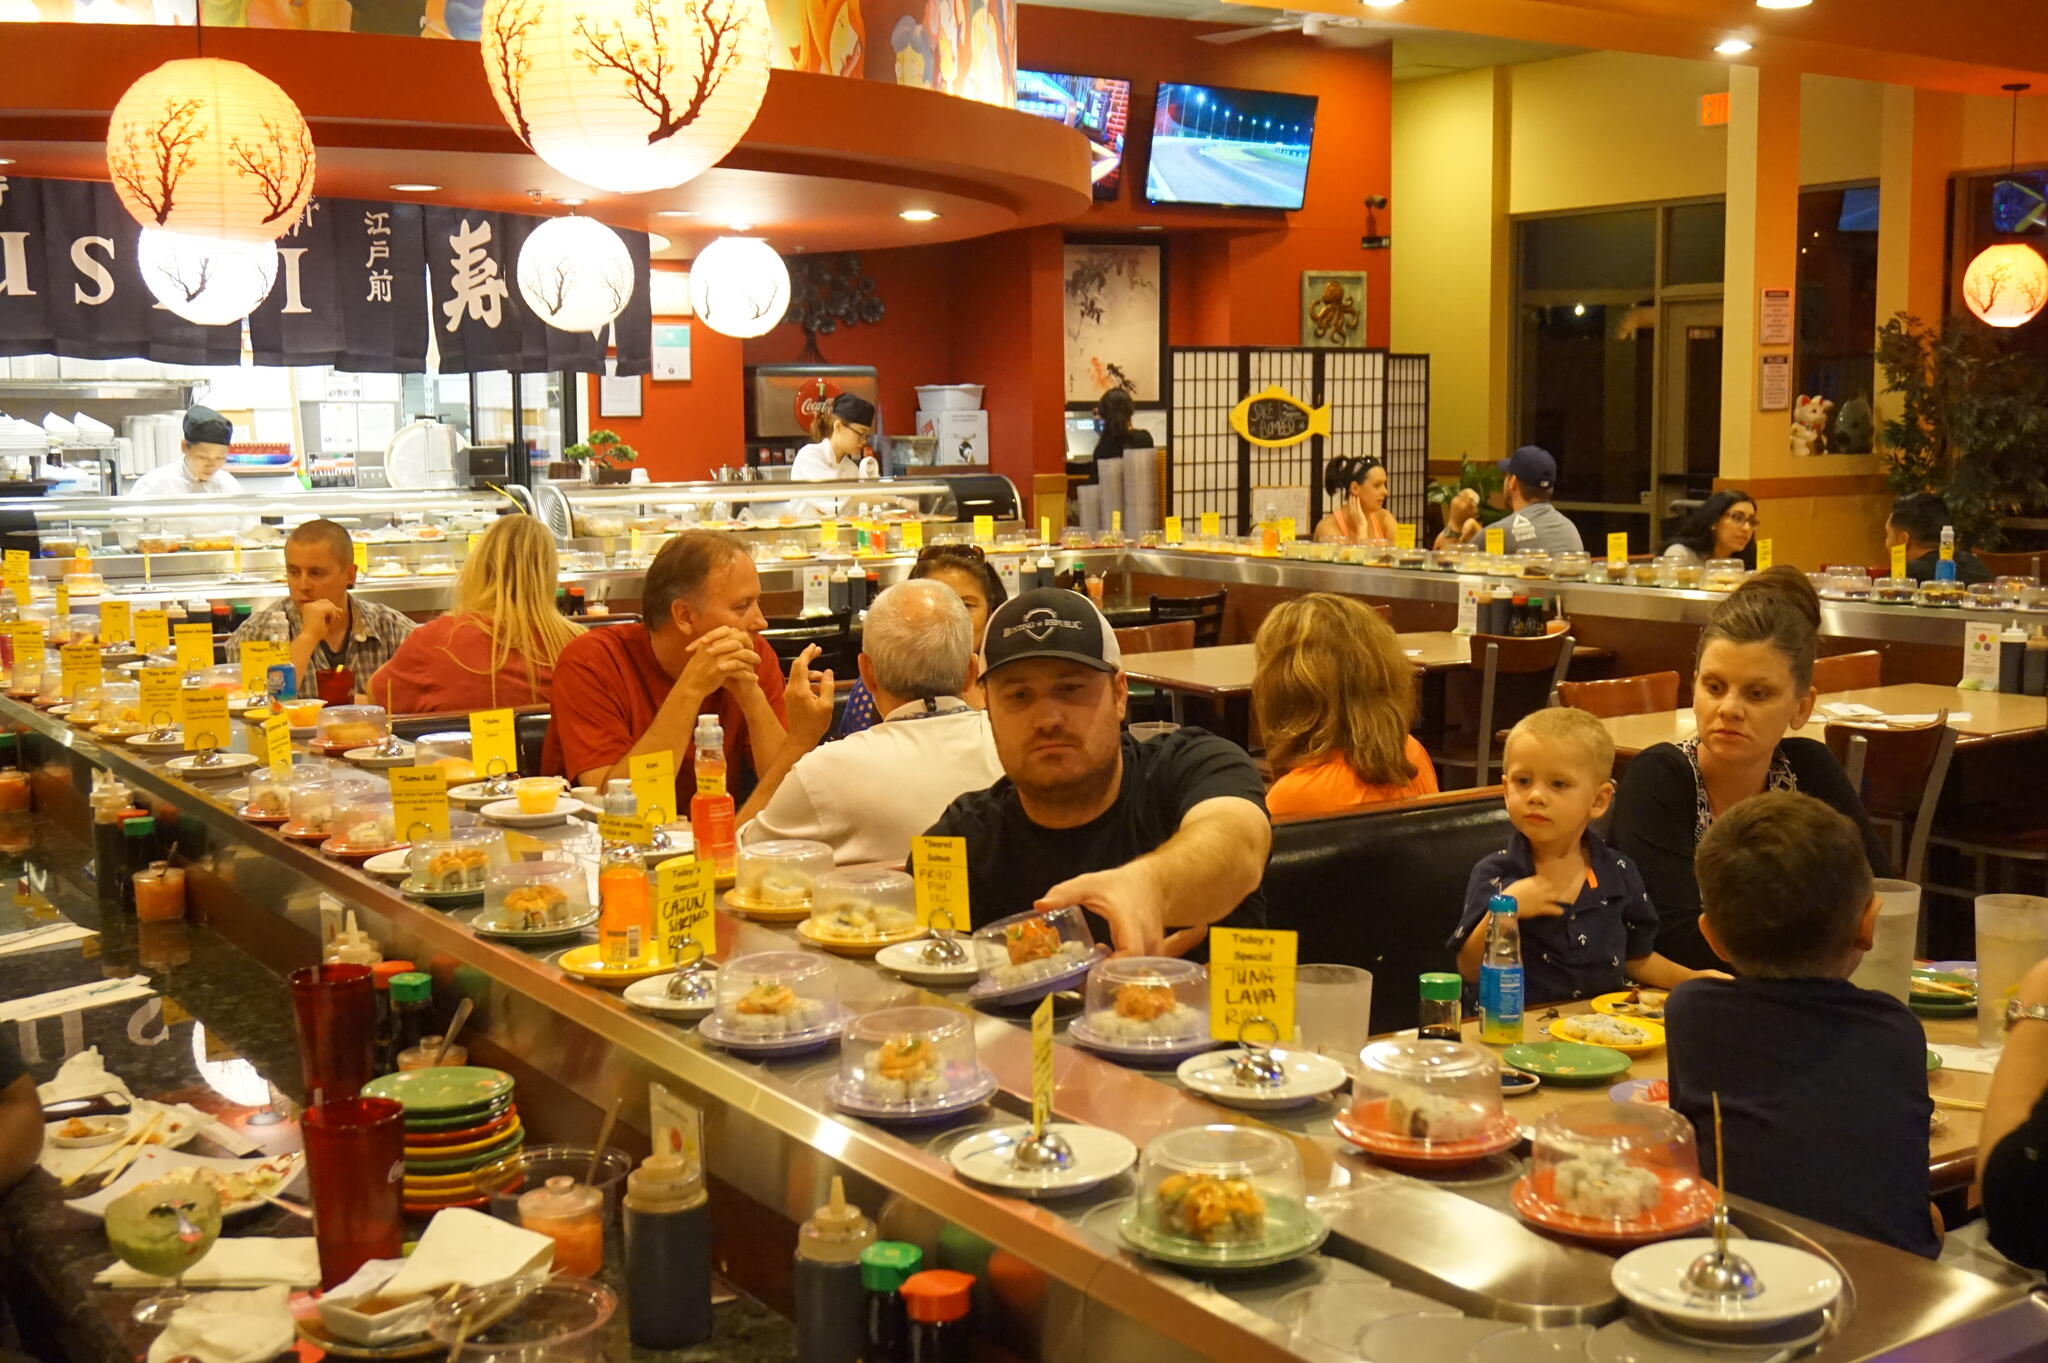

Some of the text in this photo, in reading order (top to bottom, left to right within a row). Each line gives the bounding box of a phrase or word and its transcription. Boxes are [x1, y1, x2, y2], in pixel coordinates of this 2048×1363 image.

[443, 217, 509, 333] 寿
[672, 866, 702, 878] Today's
[673, 881, 699, 892] Special
[663, 891, 706, 919] CAJUN
[1232, 933, 1275, 946] Today's
[1234, 951, 1272, 962] Special
[1223, 966, 1275, 986] TUNA
[1225, 987, 1277, 1005] LAVA
